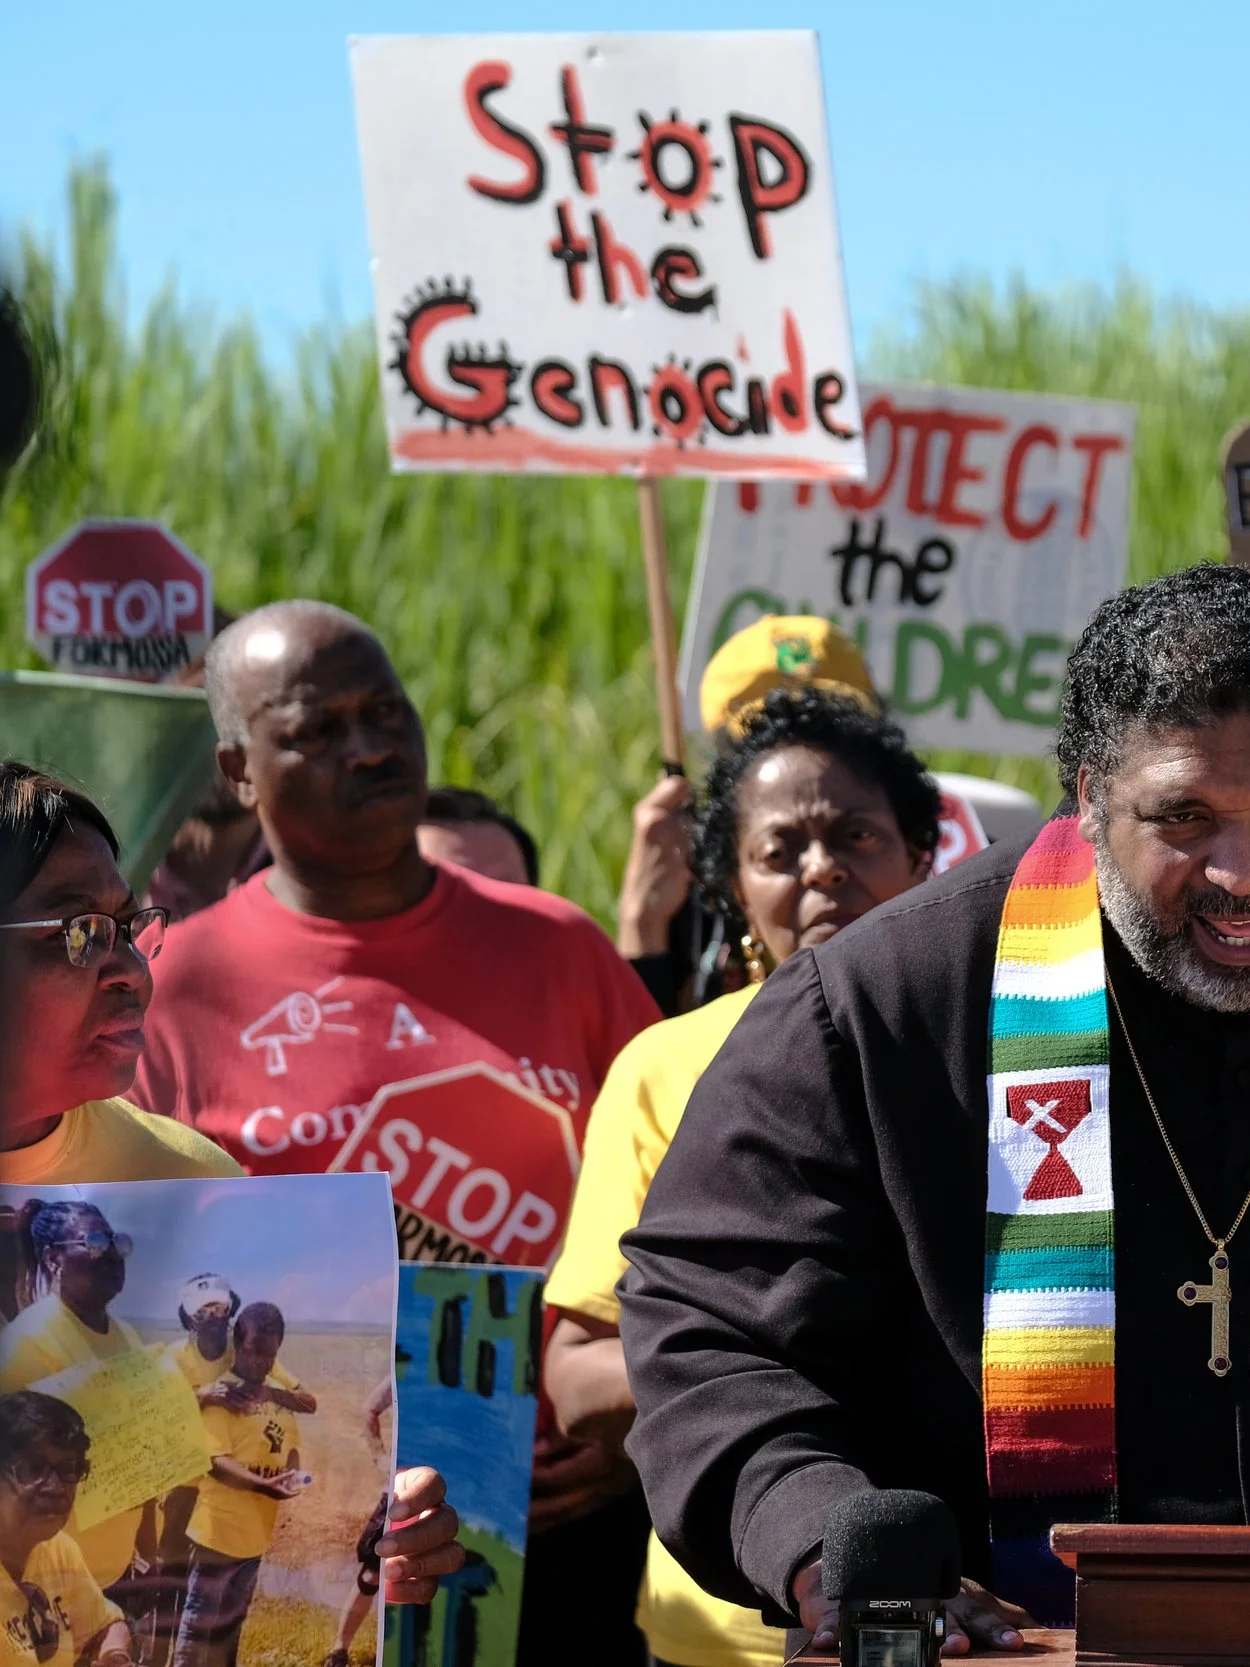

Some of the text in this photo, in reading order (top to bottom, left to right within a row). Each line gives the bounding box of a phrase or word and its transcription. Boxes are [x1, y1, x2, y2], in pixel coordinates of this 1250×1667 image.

[463, 59, 811, 259] Stop
[549, 200, 717, 316] the
[391, 278, 860, 447] Genocide
[736, 396, 1126, 542] OTECT
[43, 579, 198, 638] STOP
[831, 518, 956, 607] the
[386, 1002, 437, 1050] A
[361, 1117, 557, 1255] STOP
[869, 1600, 911, 1608] ZOOM
